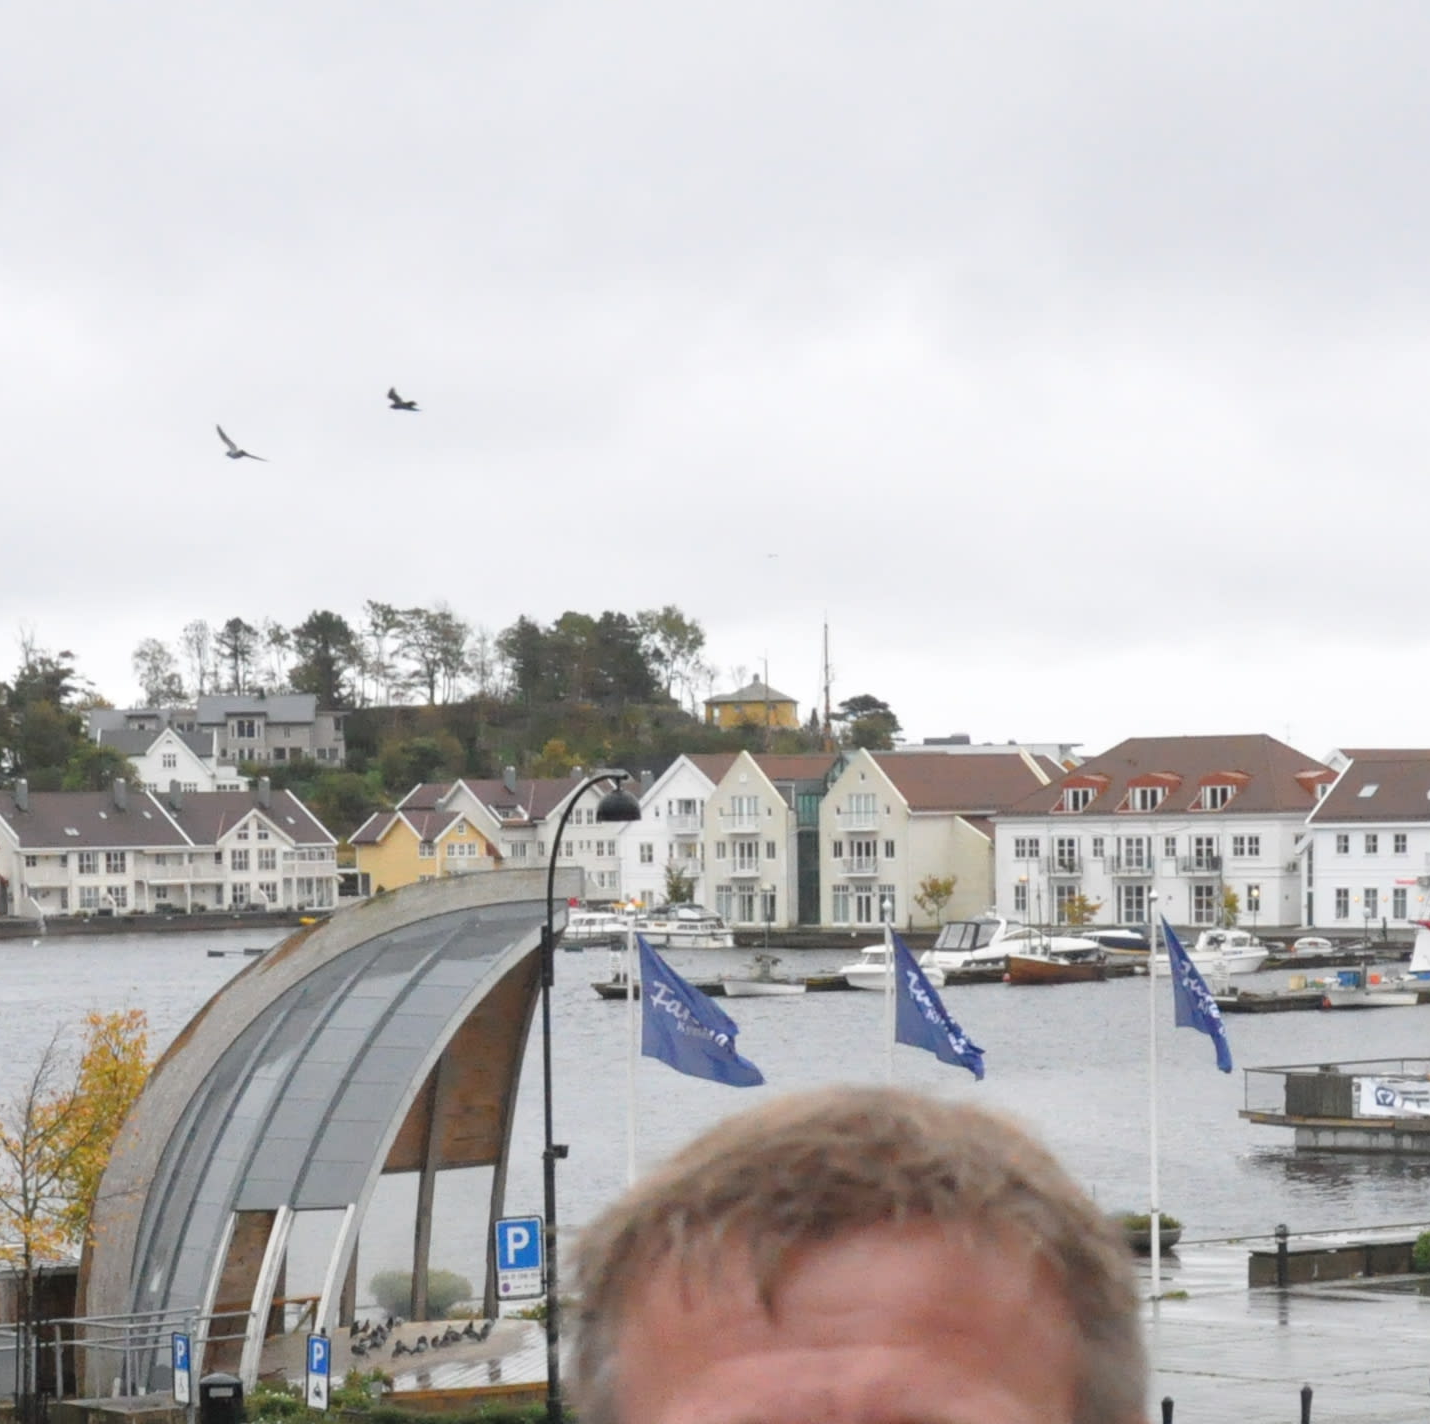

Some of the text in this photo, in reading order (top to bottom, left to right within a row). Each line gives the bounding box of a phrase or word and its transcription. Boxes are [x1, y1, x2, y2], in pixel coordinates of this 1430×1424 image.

[507, 1226, 530, 1264] P
[176, 1340, 185, 1365] P
[313, 1342, 324, 1369] P
